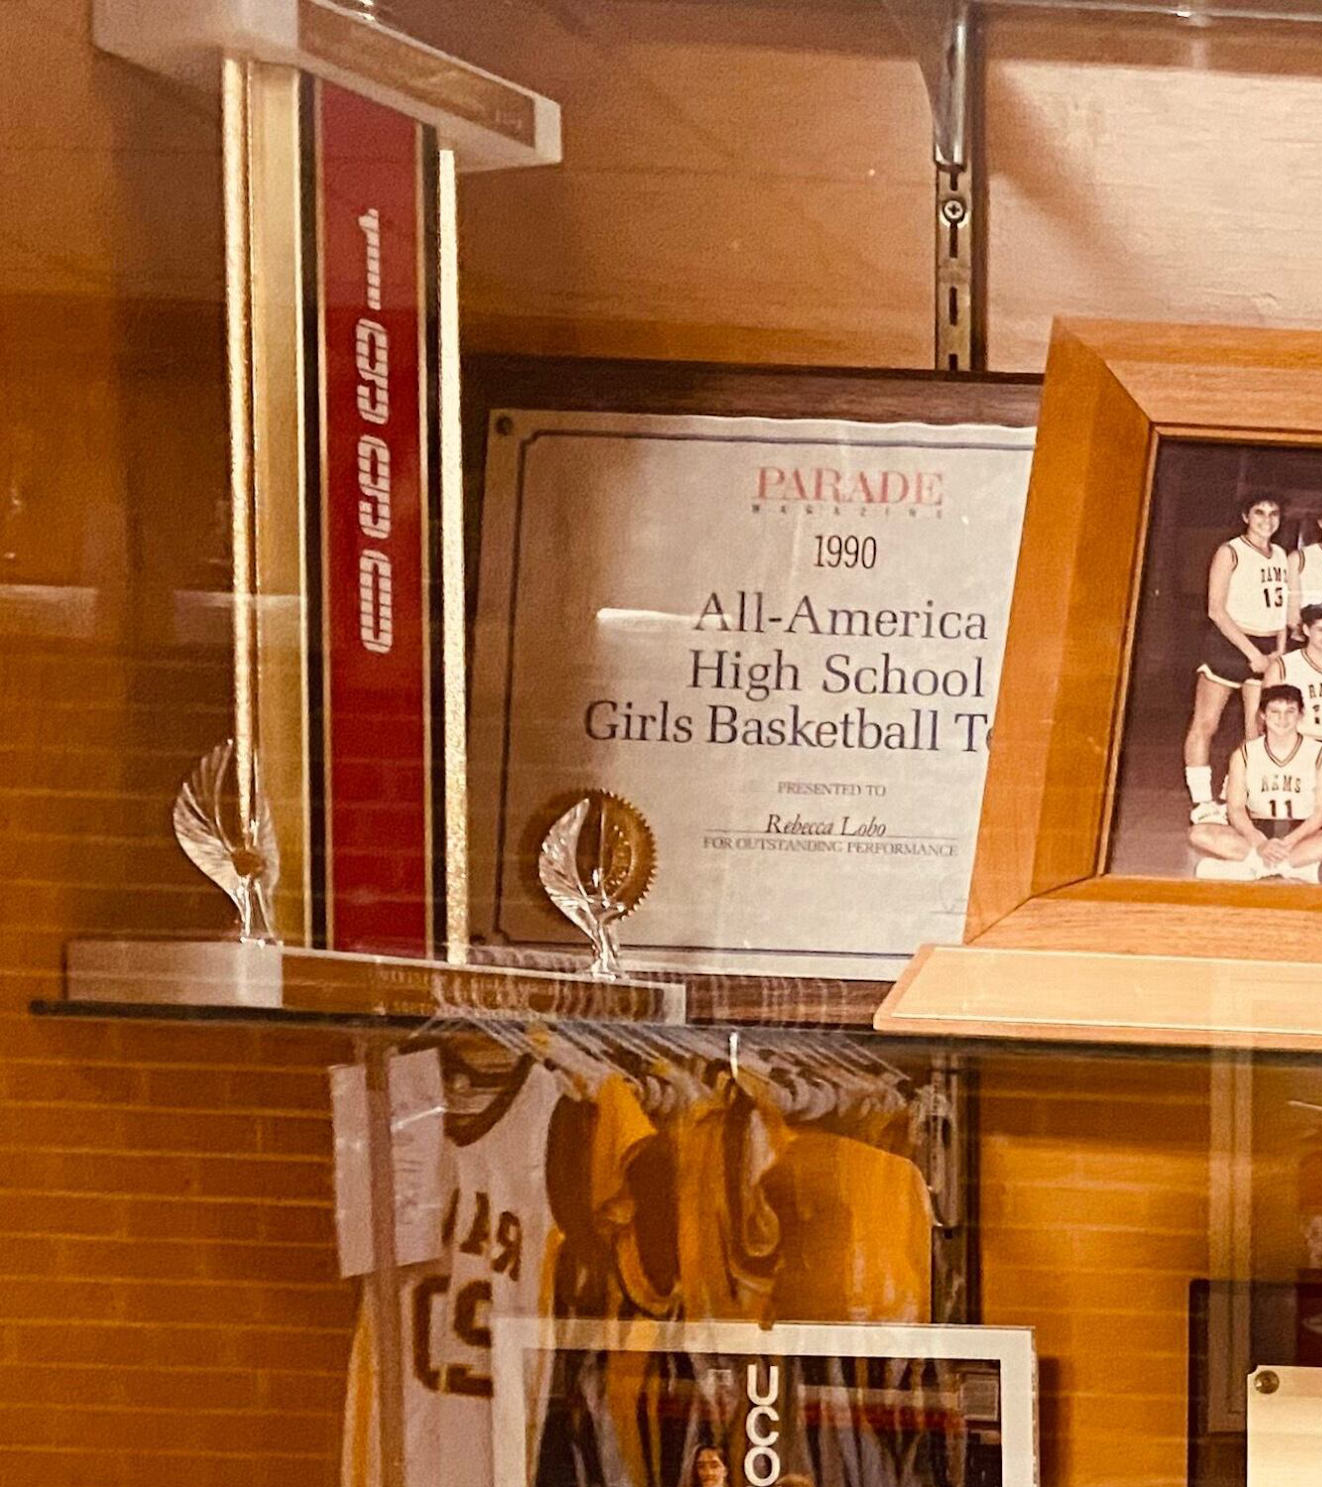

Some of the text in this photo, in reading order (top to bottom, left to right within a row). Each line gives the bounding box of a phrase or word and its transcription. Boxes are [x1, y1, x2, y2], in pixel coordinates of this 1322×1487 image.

[356, 208, 392, 653] 1990
[753, 466, 944, 506] PARADE
[813, 535, 877, 570] 1990
[1263, 587, 1283, 608] 13
[693, 591, 988, 640] All-America
[686, 648, 985, 702] High School
[585, 700, 693, 744] Girls
[707, 703, 940, 751] Basketball
[777, 782, 886, 796] PRESENTED TO
[1261, 774, 1301, 793] RAMS
[1269, 799, 1293, 818] 11
[765, 813, 887, 837] Rebecca Lobo
[703, 837, 958, 857] FOR OUTSTANDING PERFORMANCE
